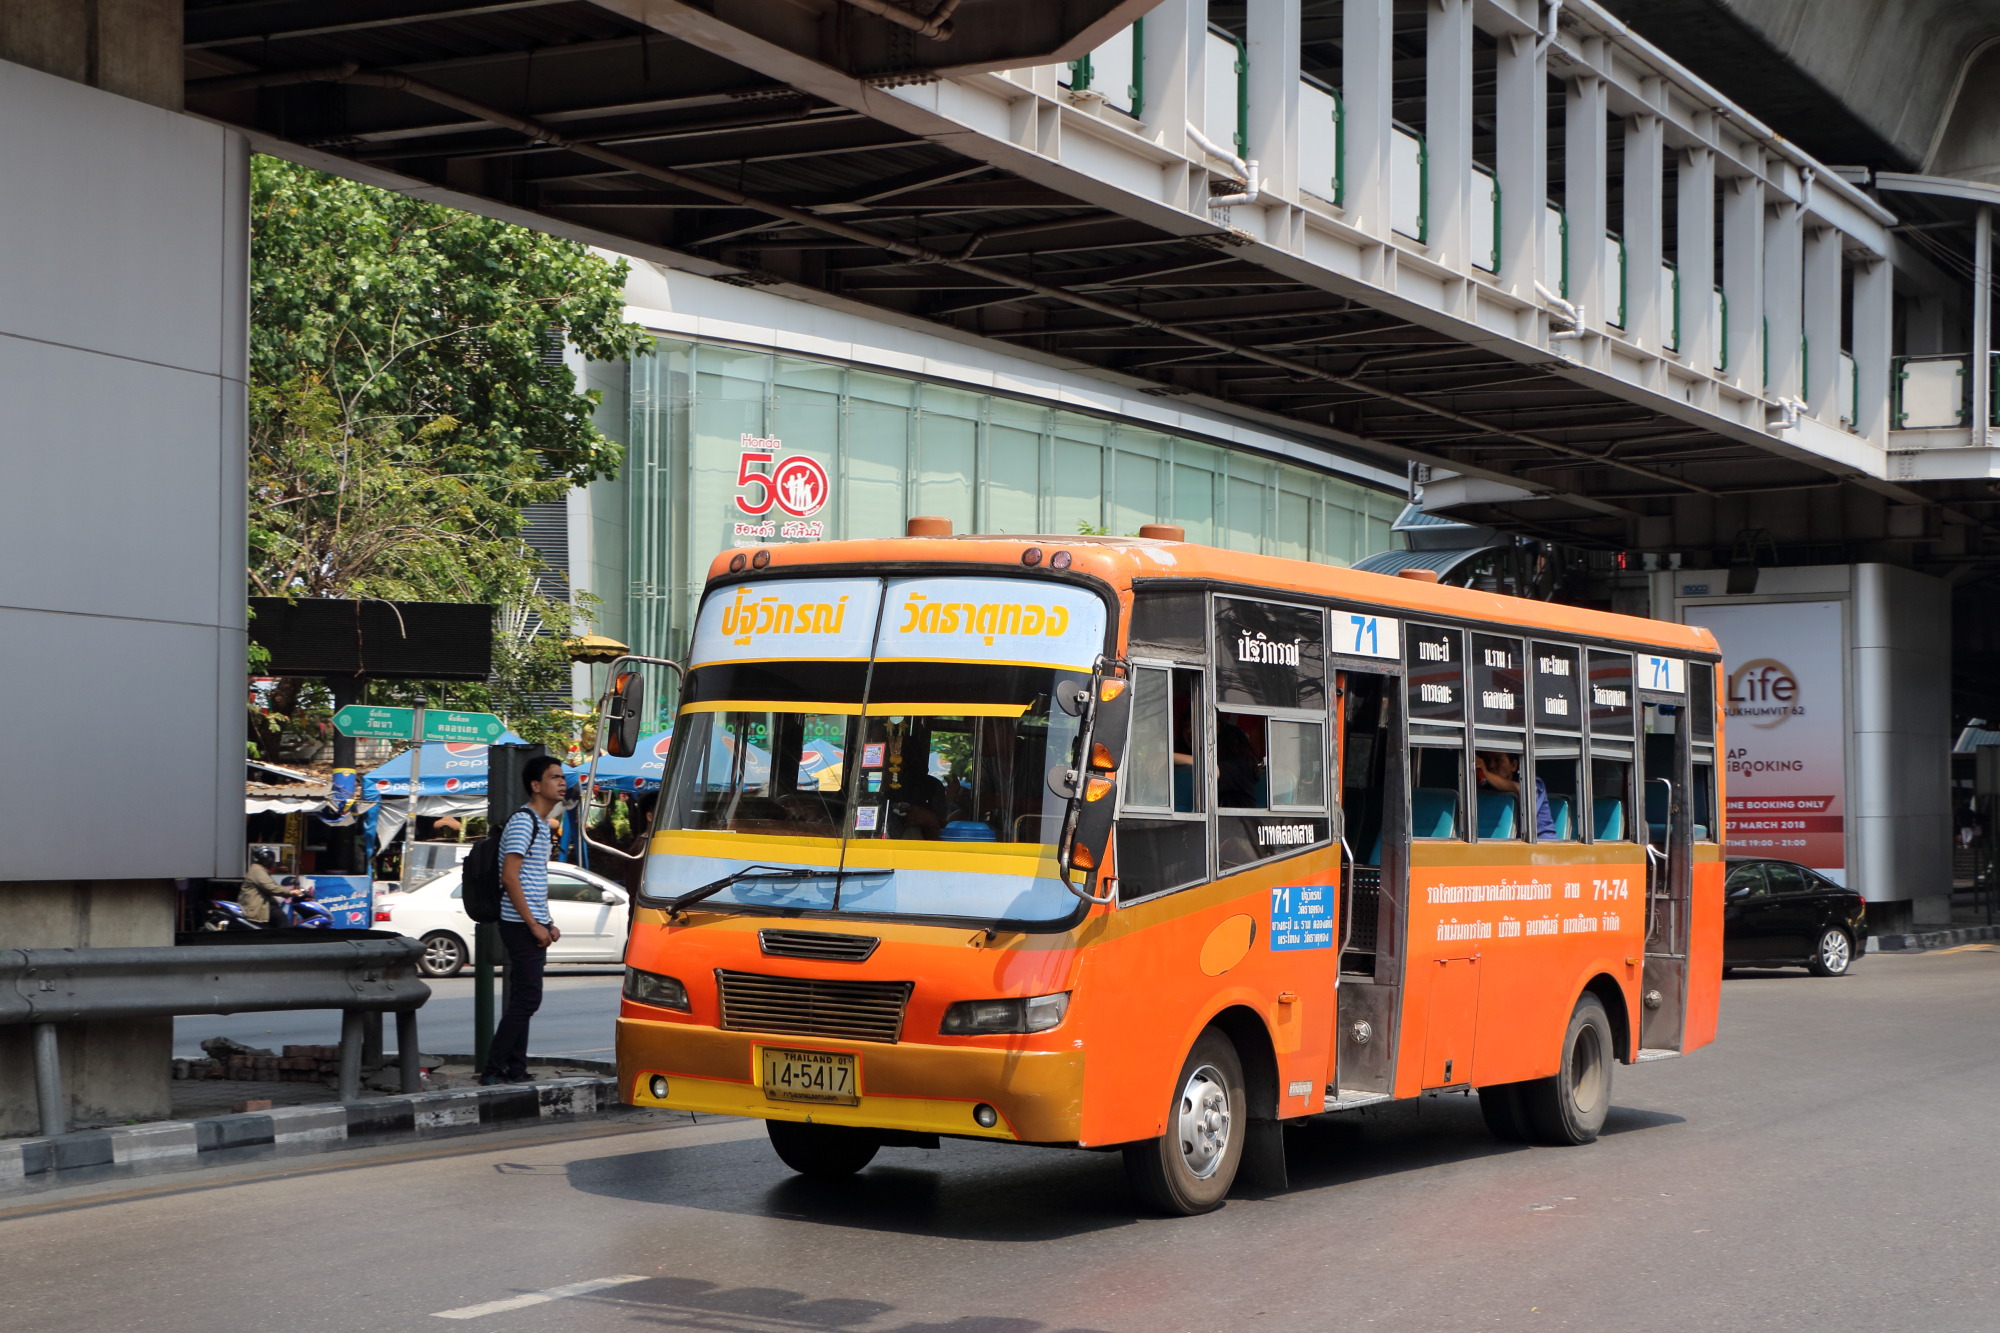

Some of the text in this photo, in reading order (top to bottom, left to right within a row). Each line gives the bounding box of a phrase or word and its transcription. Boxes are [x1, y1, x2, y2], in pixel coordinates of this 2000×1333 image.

[741, 433, 781, 448] Honda
[735, 452, 830, 517] 50
[734, 520, 824, 539] ฮอนด้า ห้าสิบปี
[721, 586, 849, 646] ปัฐวิกรณ์
[899, 592, 1070, 646] วัดธาตุทอง
[1351, 615, 1378, 654] 71
[1238, 629, 1301, 666] ปัฐวิกรณ์
[1419, 636, 1450, 662] บางกะปิ
[1539, 654, 1569, 676] พระโขนง
[1650, 658, 1670, 689] 71
[1420, 683, 1452, 703] การเคหะ
[1727, 666, 1797, 702] Life
[1482, 688, 1515, 710] คลองตัน
[1544, 693, 1568, 715] เอกมัย
[1593, 683, 1626, 712] วัดธาตุทอง
[1724, 706, 1805, 717] SUKHUMVIT 62
[445, 759, 488, 769] peps
[1727, 748, 1747, 759] AP
[393, 781, 425, 791] pesi
[1746, 801, 1795, 809] BOOKING
[1797, 800, 1825, 808] ONLY
[1257, 824, 1315, 845] บาทตลอดสาย
[1739, 821, 1778, 829] MARCH
[1780, 820, 1806, 829] 2018
[1726, 839, 1747, 847] TIME
[1749, 839, 1773, 847] 19:00
[1781, 839, 1806, 847] 21:00
[1272, 888, 1290, 914] 71
[1427, 878, 1629, 904] รถโดยสารขนาดเล็กร่วมบริการ สาย 71-74
[1436, 917, 1492, 941] ดำเนินการโดย
[1498, 915, 1521, 938] บริษัท
[1563, 913, 1598, 934] การเดินรถ
[1602, 912, 1620, 931] จำกัด
[784, 1053, 832, 1064] THAILAND
[772, 1061, 849, 1092] 14-5417
